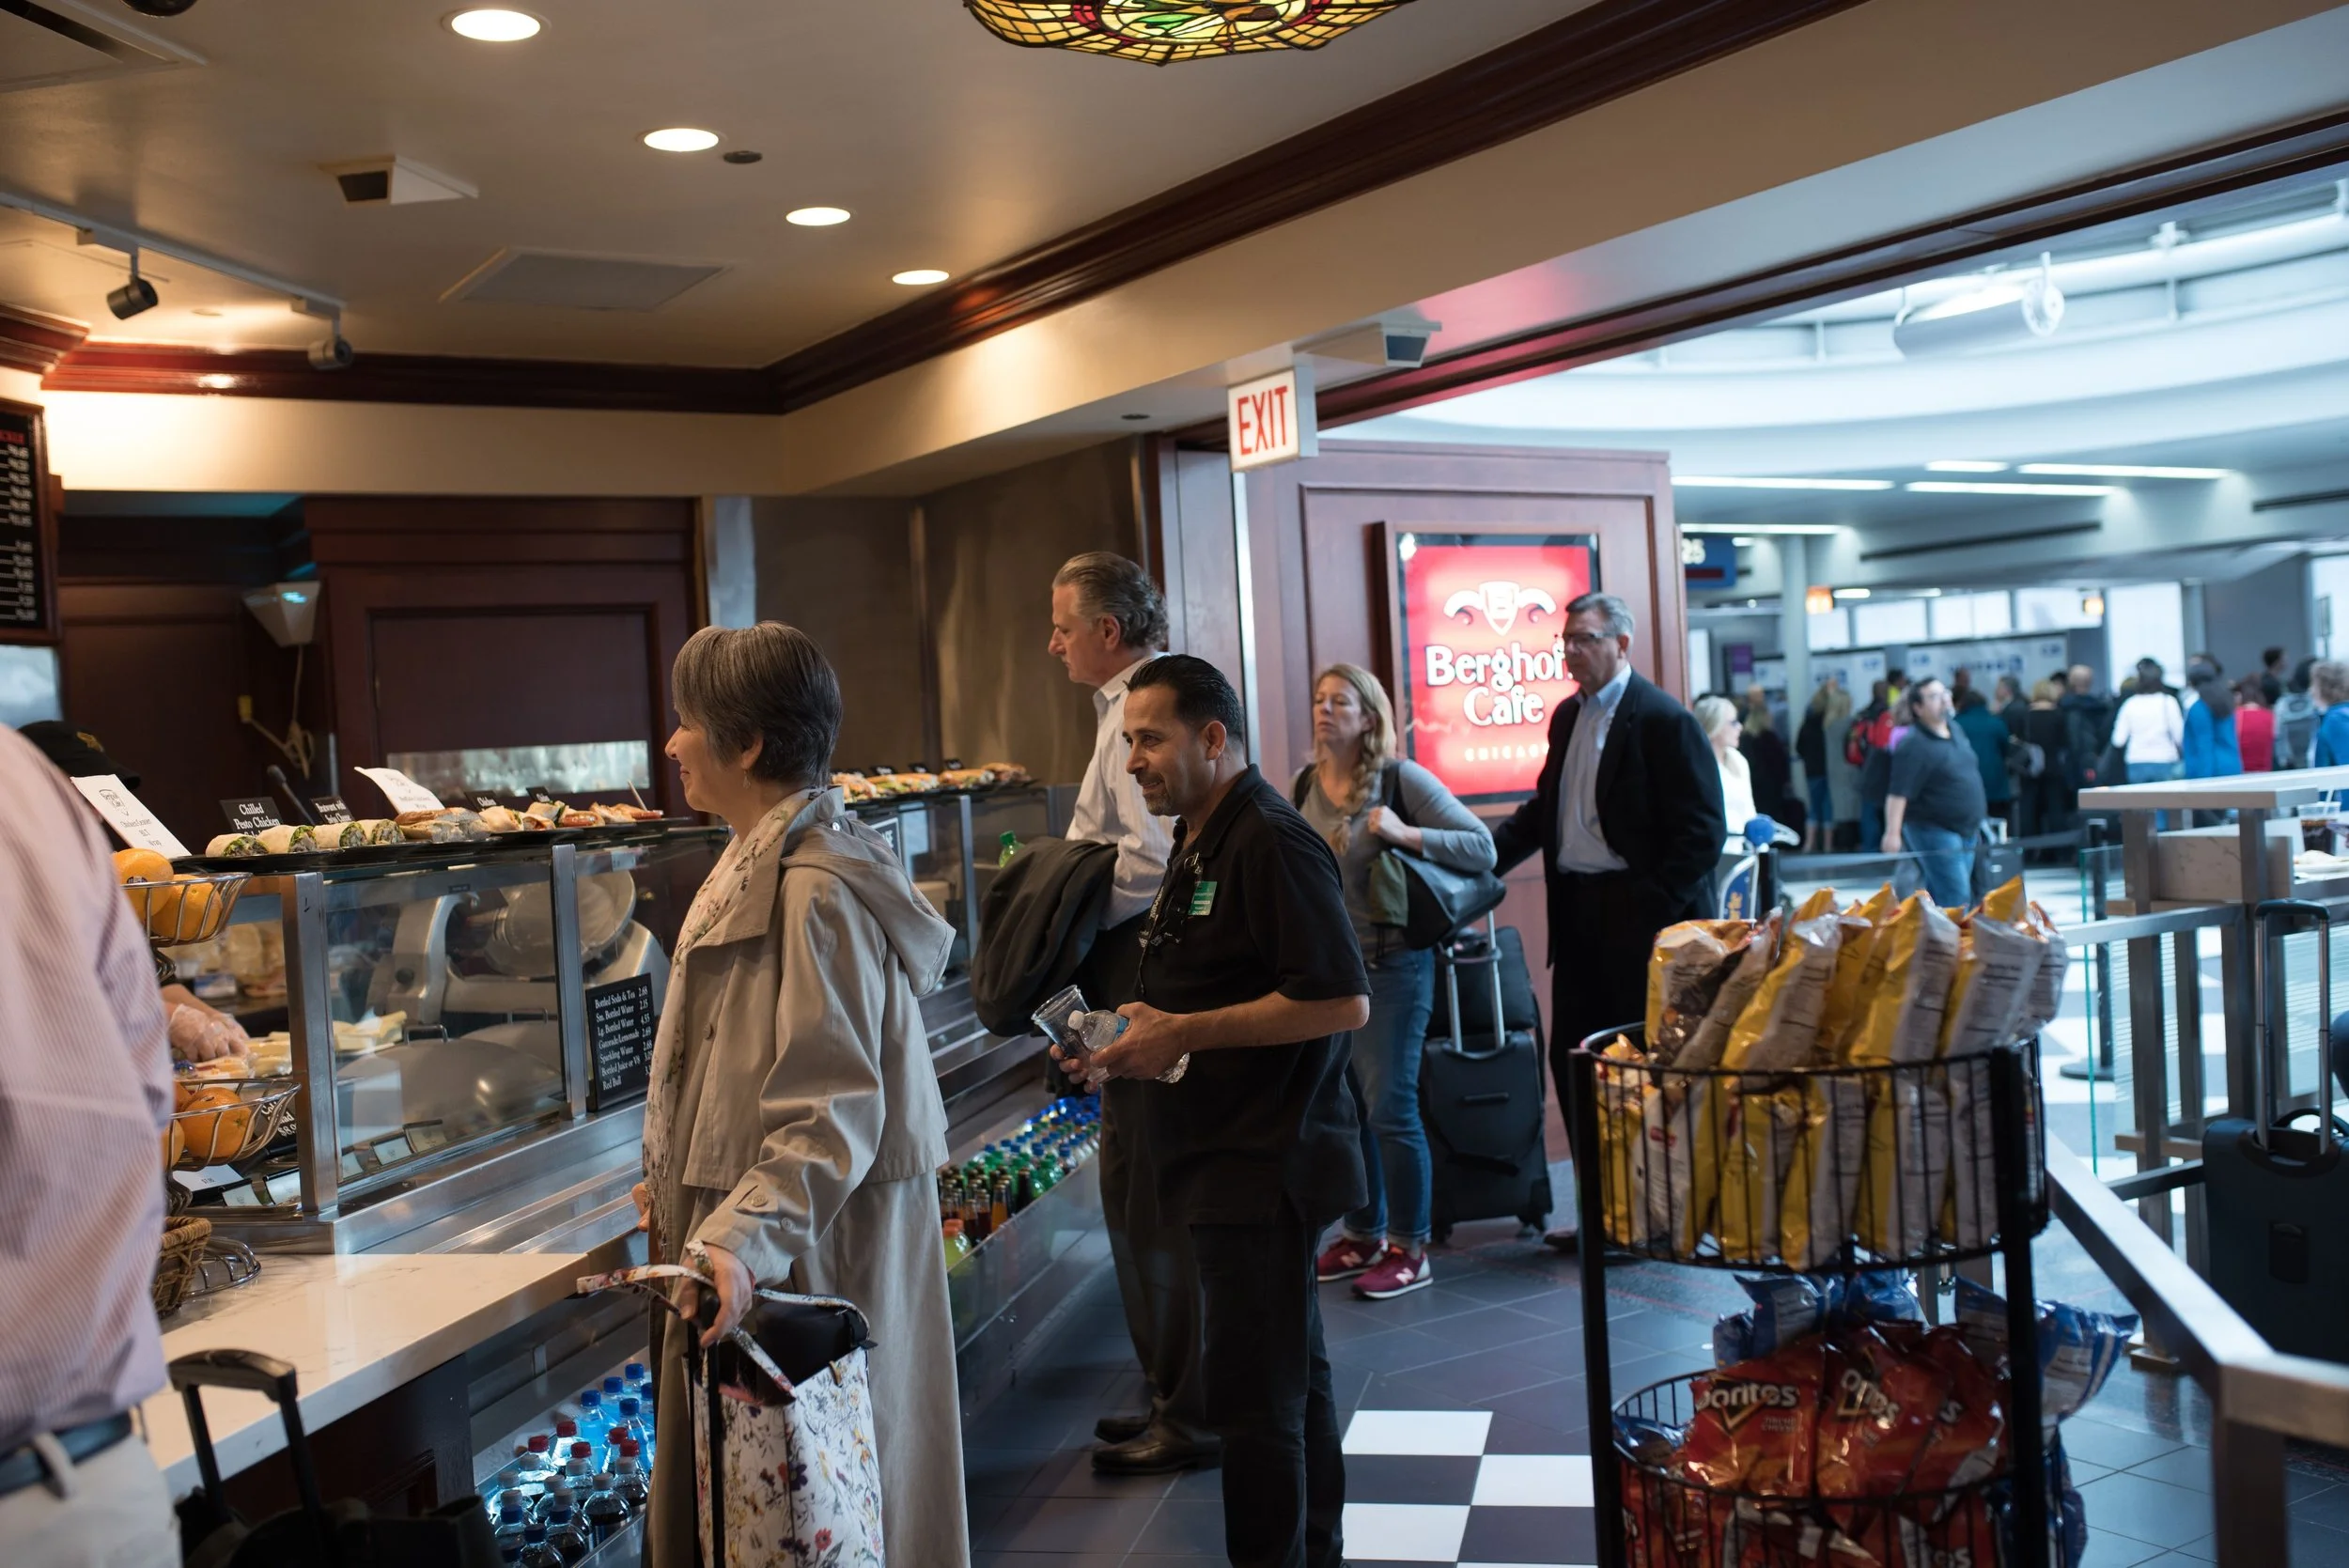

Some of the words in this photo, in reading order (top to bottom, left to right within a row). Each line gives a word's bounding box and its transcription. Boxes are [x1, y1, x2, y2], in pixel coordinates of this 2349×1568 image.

[1237, 385, 1288, 456] EXIT
[1425, 635, 1573, 692] Berghof
[239, 802, 264, 815] Chilled
[233, 818, 254, 830] Pesto
[253, 815, 281, 828] Chicken
[627, 989, 636, 1000] Tea
[602, 1079, 612, 1090] Red
[612, 1075, 622, 1088] Bull
